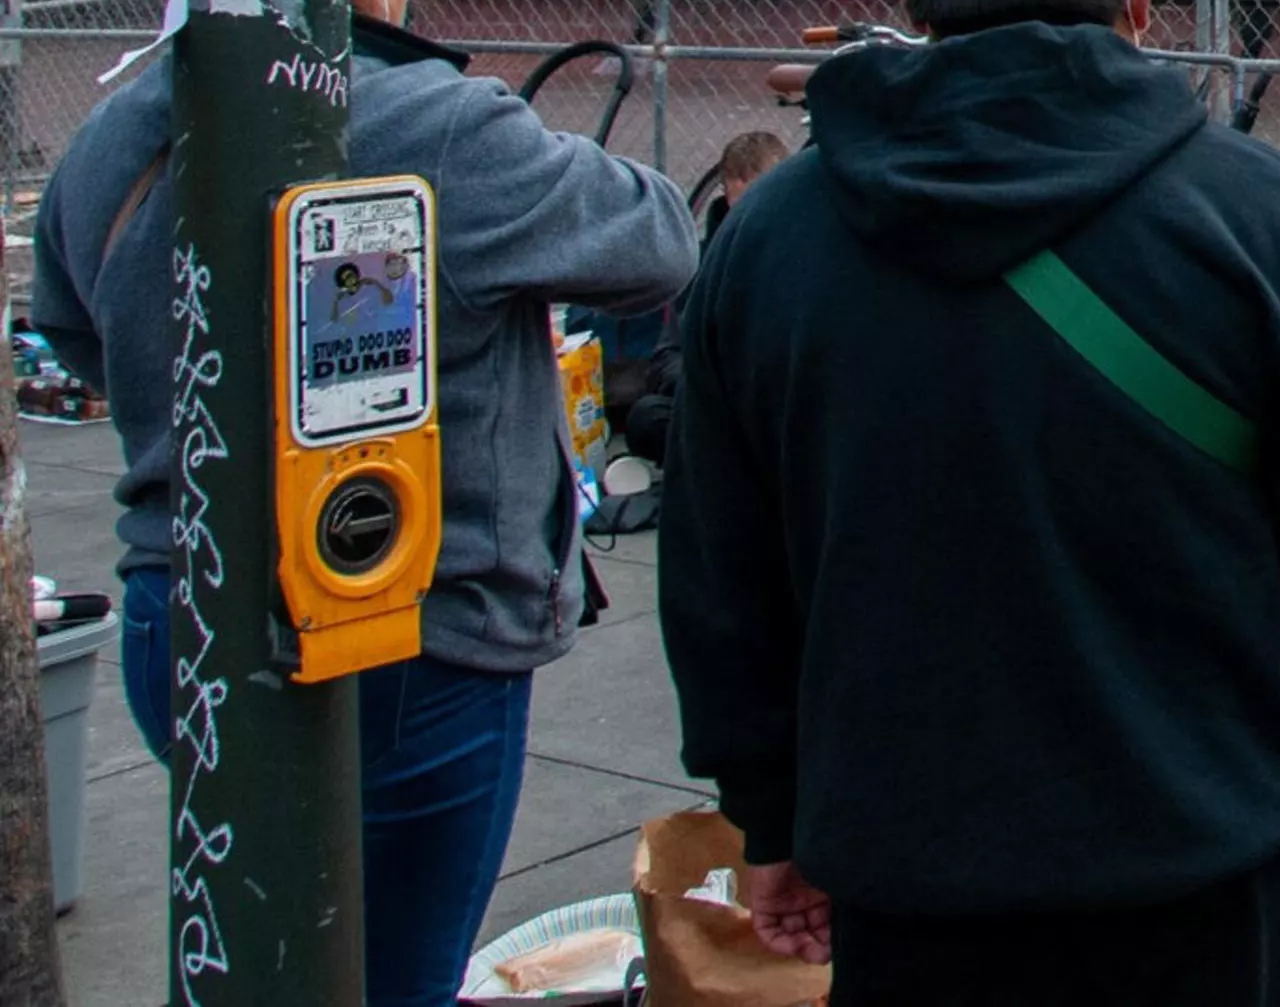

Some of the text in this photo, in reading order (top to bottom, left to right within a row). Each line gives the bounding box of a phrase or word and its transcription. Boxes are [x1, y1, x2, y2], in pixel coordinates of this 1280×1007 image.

[359, 331, 383, 352] DOO
[387, 327, 412, 347] DOO
[313, 349, 411, 378] DUMB
